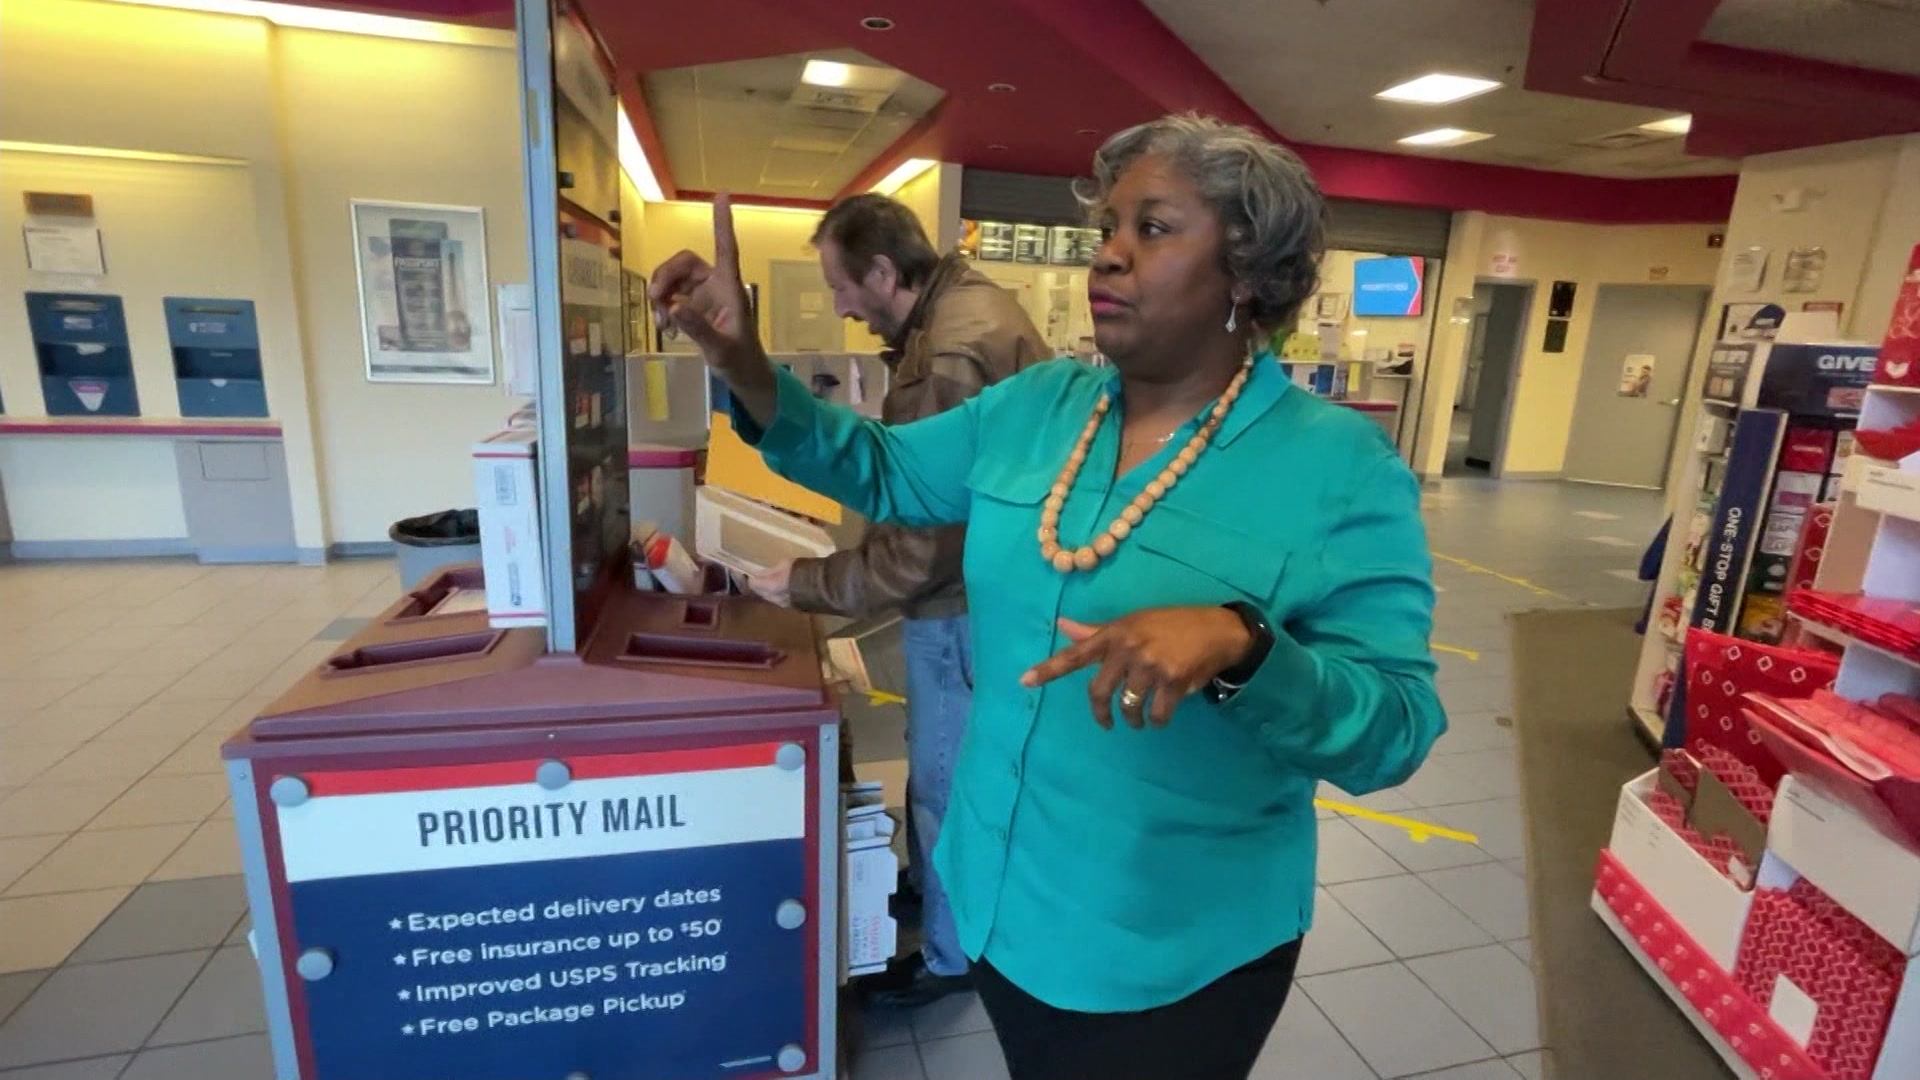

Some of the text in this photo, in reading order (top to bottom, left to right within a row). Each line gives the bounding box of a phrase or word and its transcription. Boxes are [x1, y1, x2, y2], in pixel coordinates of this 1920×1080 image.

[1818, 354, 1878, 371] GIVE
[1714, 507, 1742, 580] ONE-STOP
[1706, 583, 1723, 616] GIFT
[417, 794, 686, 847] PRIORITY MAIL
[408, 902, 535, 932] Expected
[543, 896, 646, 919] delivery
[412, 948, 472, 967] Free
[481, 936, 601, 960] insurance
[608, 932, 641, 949] up
[648, 926, 673, 943] to
[416, 972, 541, 1002] Improved
[549, 964, 618, 988] USPS
[420, 1018, 480, 1036] Free
[487, 1004, 596, 1029] Package
